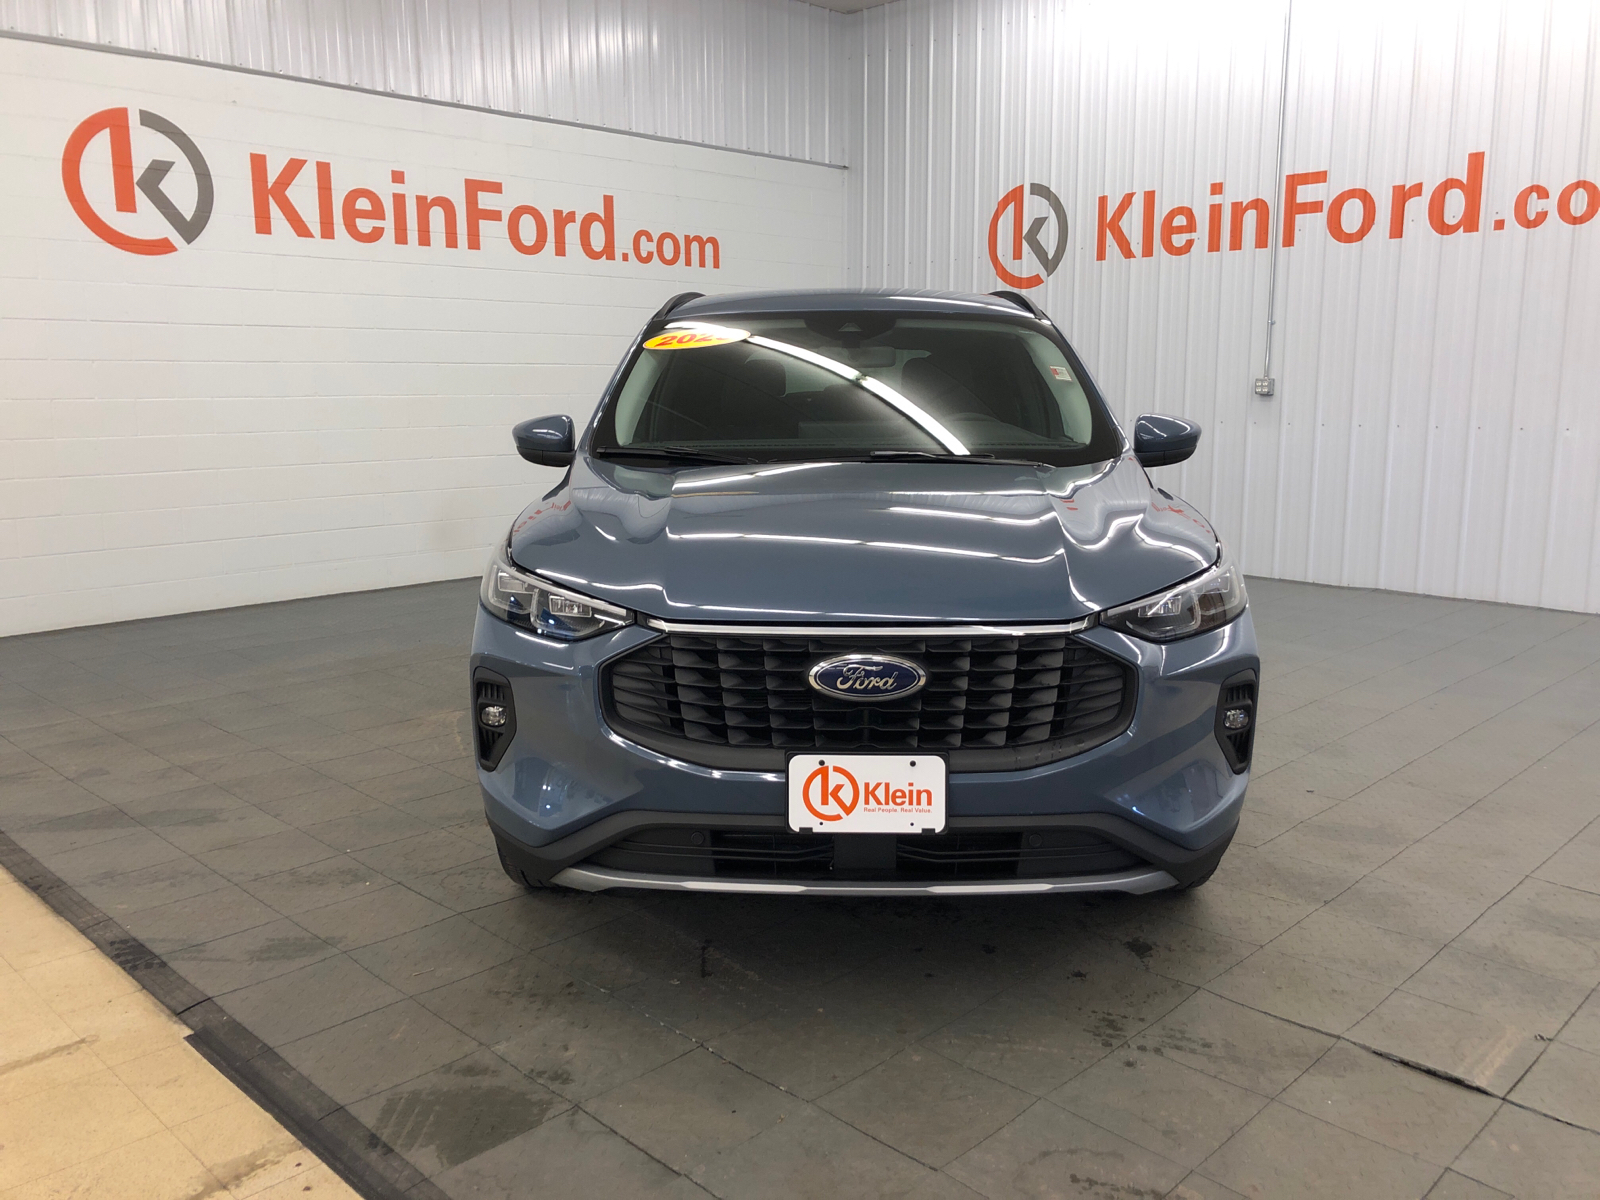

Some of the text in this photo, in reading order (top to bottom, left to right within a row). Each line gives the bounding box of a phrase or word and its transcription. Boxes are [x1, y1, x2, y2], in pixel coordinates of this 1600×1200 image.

[249, 152, 721, 269] KleinFord.com
[1096, 151, 1600, 262] KleinFord.co
[653, 332, 729, 348] 202
[836, 664, 899, 691] Ford
[863, 781, 933, 807] Klein
